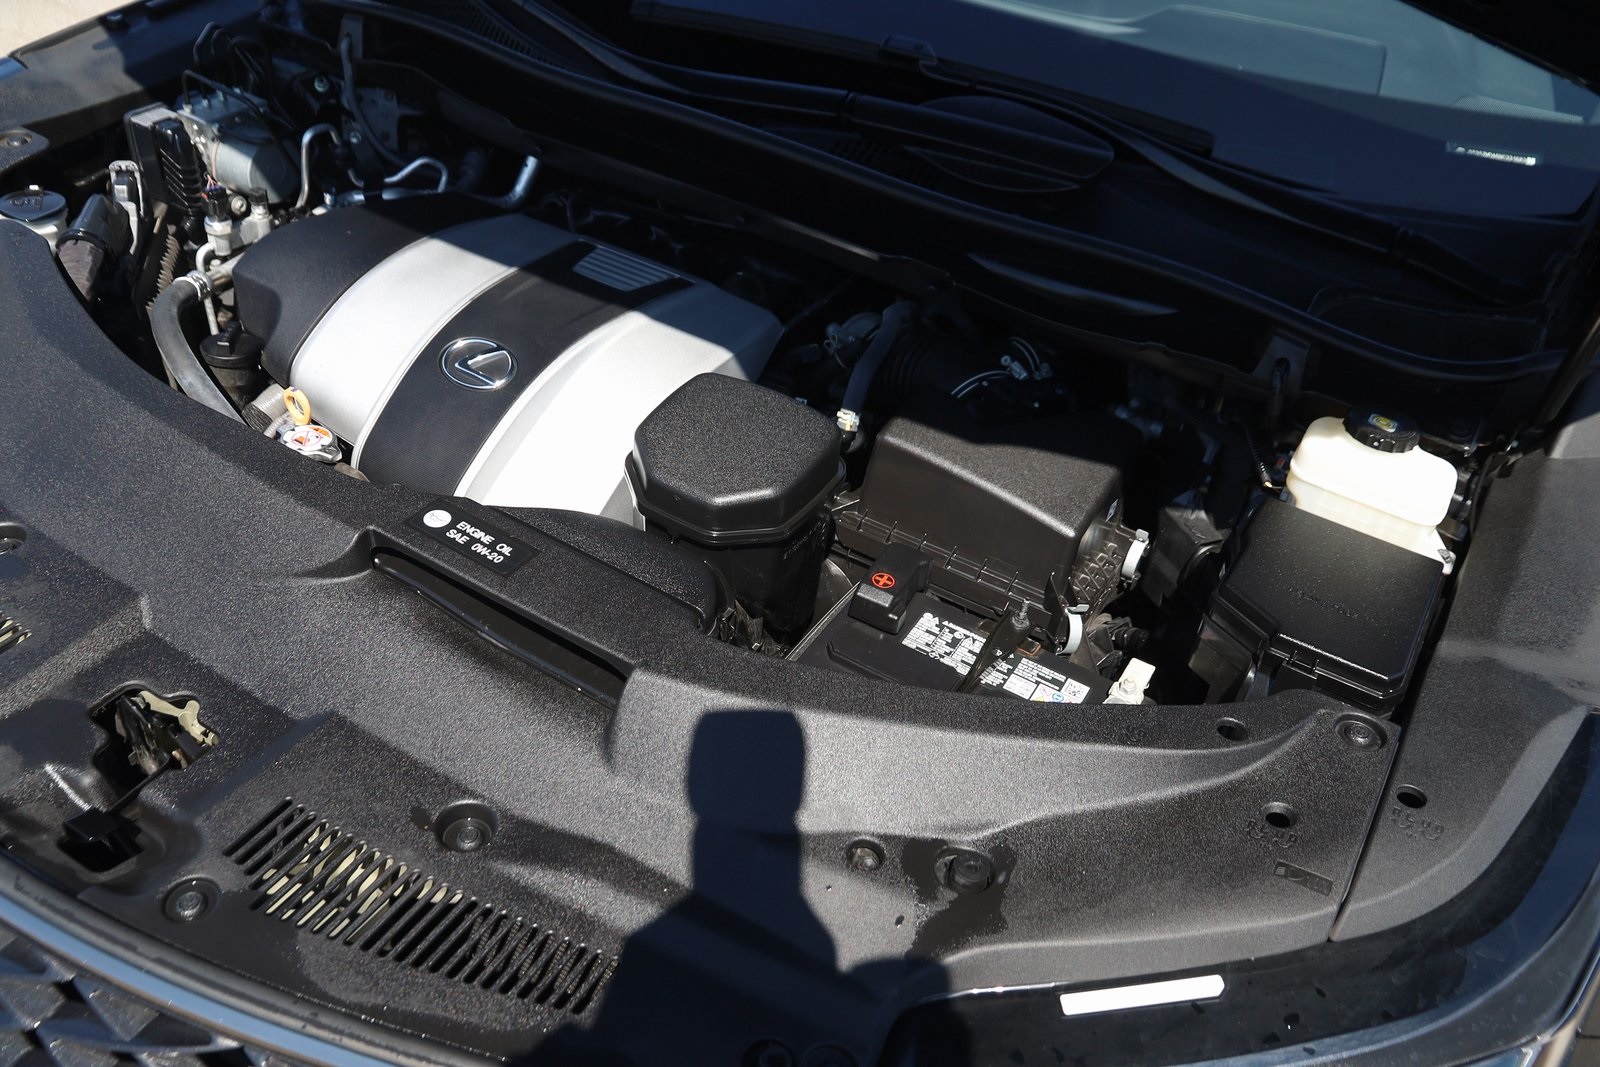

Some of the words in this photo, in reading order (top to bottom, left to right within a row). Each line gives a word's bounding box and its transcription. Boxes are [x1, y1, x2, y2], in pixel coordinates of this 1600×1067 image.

[446, 529, 470, 545] SAE
[471, 543, 504, 563] 0W-20
[456, 521, 495, 545] ENGINE
[496, 543, 513, 557] OIL
